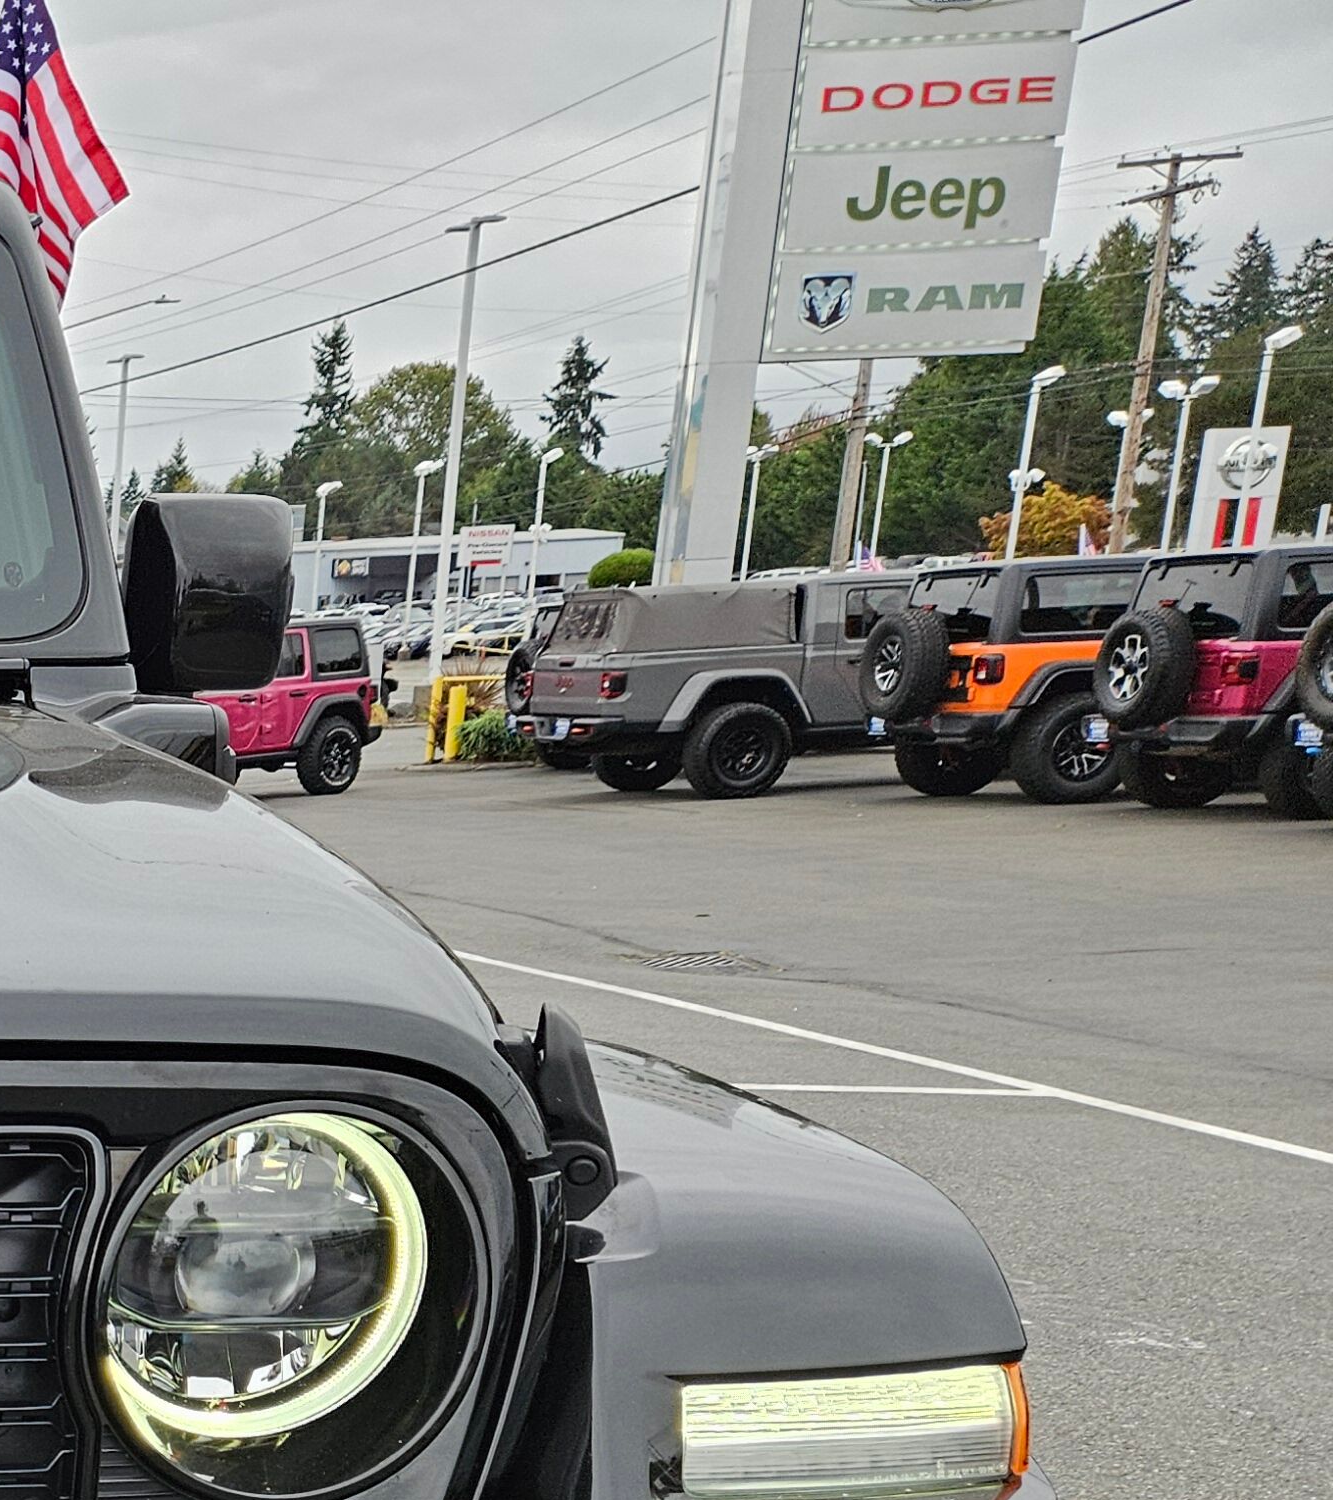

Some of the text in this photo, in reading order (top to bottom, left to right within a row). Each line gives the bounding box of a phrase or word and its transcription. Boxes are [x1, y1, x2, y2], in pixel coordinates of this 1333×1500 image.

[820, 75, 1056, 114] DODGE
[846, 165, 1006, 231] Jeep
[865, 282, 1025, 314] RAM
[468, 529, 509, 537] NISSAN
